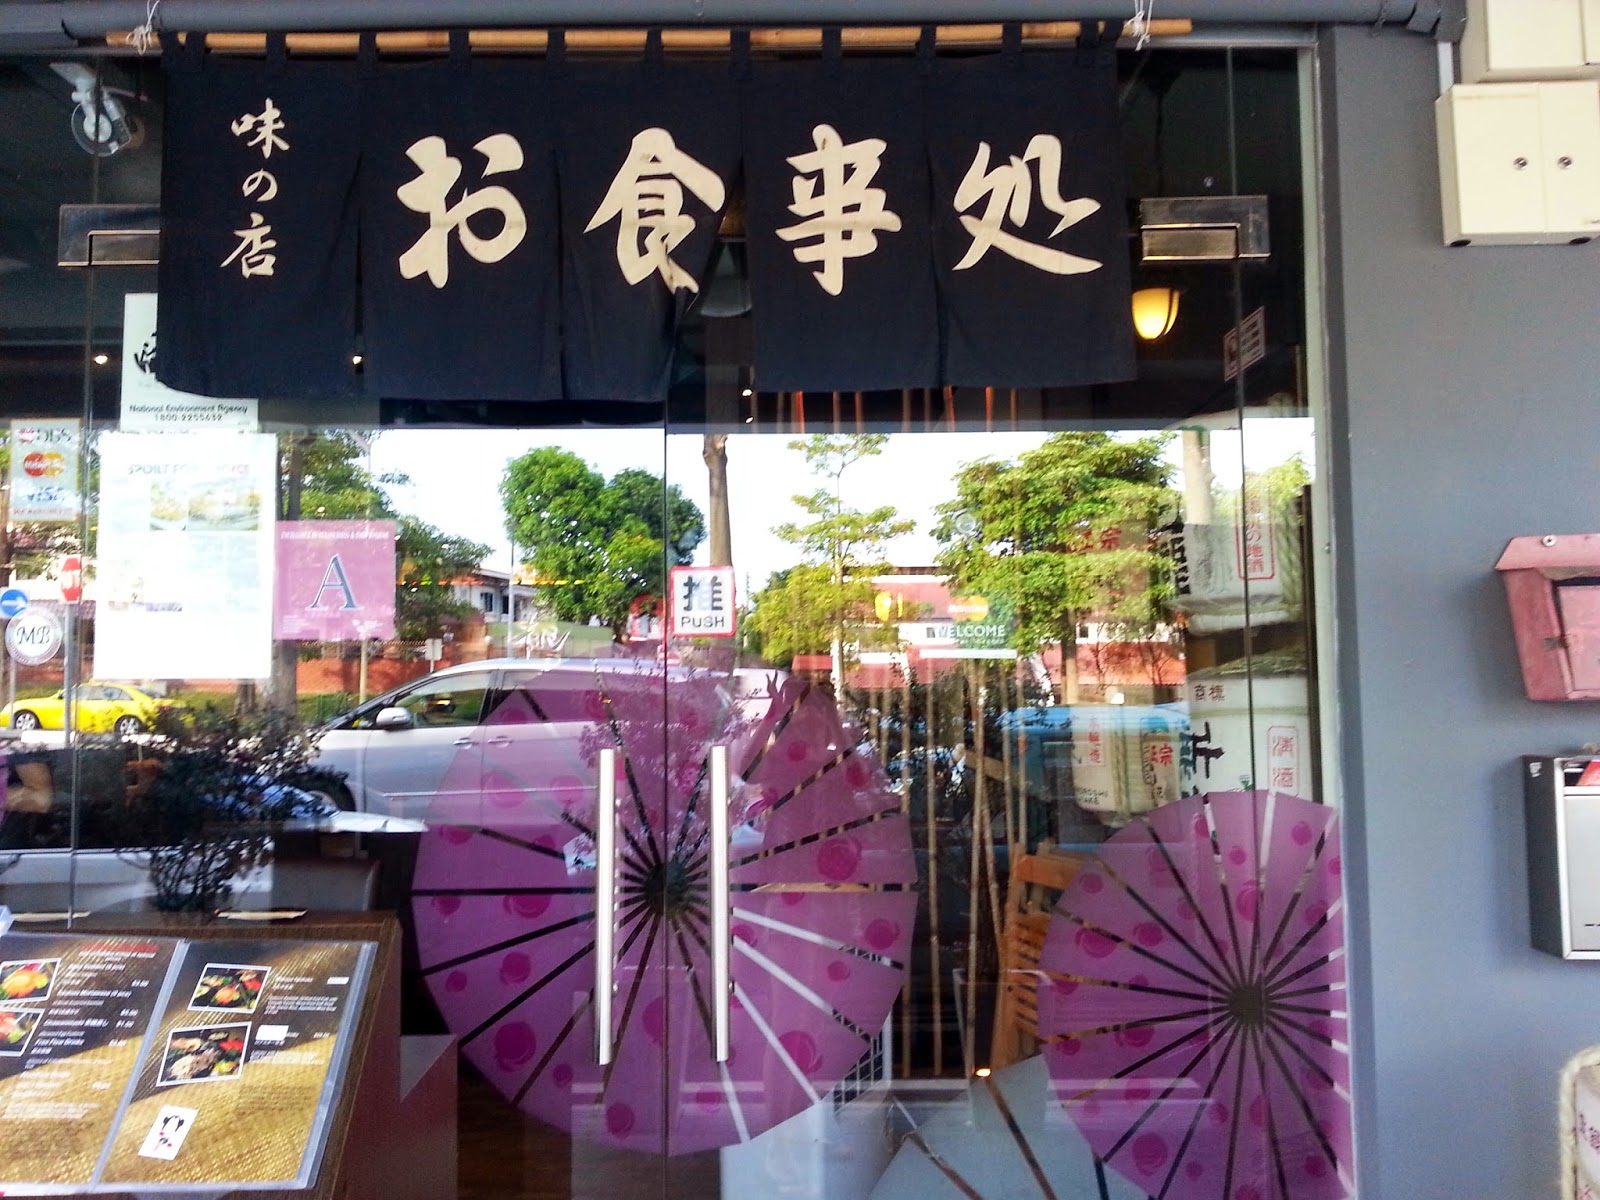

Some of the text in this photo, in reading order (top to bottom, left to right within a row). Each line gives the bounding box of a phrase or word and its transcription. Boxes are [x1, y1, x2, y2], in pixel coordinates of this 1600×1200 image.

[219, 97, 290, 279] 味の店
[396, 123, 1104, 296] お食事処
[305, 552, 364, 611] A
[682, 575, 724, 612] 推
[16, 624, 51, 646] MB
[681, 616, 725, 628] PUSH
[932, 624, 1006, 638] WELCOME
